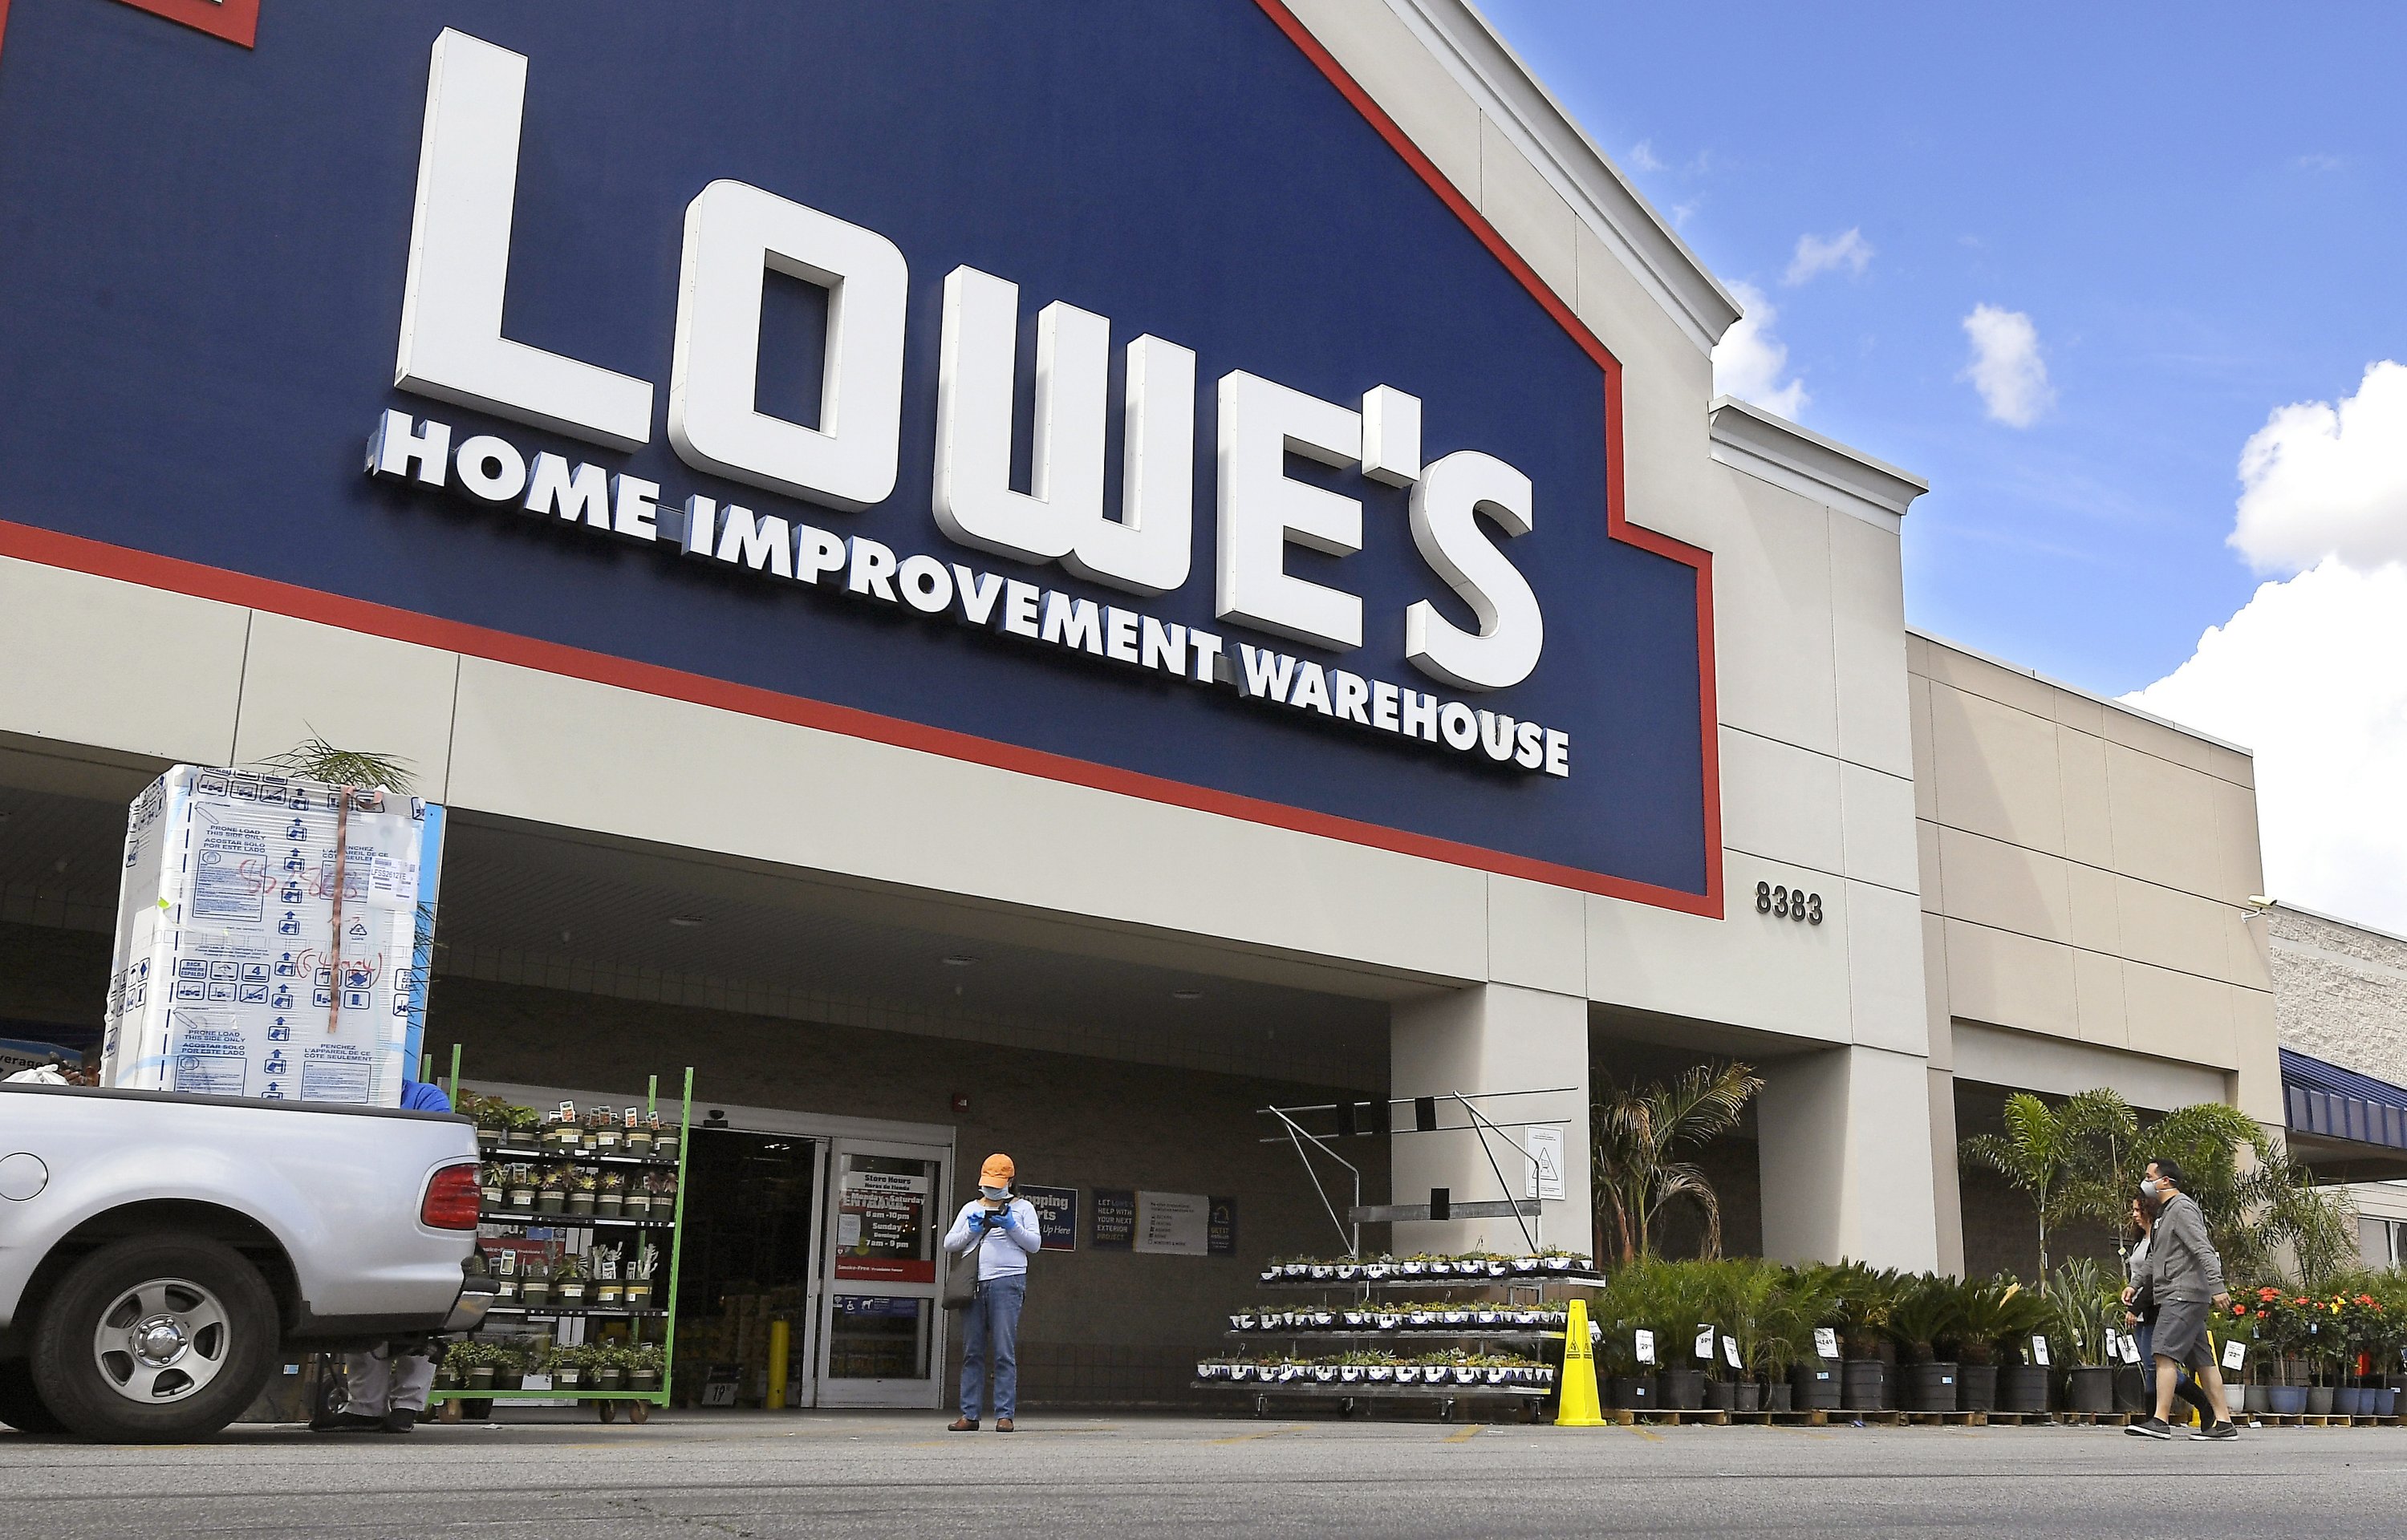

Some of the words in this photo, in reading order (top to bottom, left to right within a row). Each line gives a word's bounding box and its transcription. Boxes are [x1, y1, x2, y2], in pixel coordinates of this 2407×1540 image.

[394, 26, 1544, 690] LOWE'S
[367, 407, 661, 541] HOME
[681, 493, 1224, 684] IMPROVEMENT
[1232, 642, 1570, 779] WAREHOUSE
[210, 825, 238, 833] PRONE
[204, 837, 242, 845] ACOSTAR
[1754, 880, 1824, 926] 8383
[251, 966, 262, 975] 4
[865, 1174, 887, 1183] Store
[888, 1176, 911, 1185] Hours
[851, 1192, 883, 1202] Monday
[890, 1195, 925, 1206] Saturday
[1018, 1192, 1069, 1210] opping
[1037, 1209, 1057, 1221] rts
[872, 1222, 902, 1232] Sunday
[1043, 1225, 1053, 1236] Up
[1054, 1225, 1071, 1234] Here
[1097, 1225, 1128, 1233] EXTERIOR
[896, 1241, 909, 1249] pm
